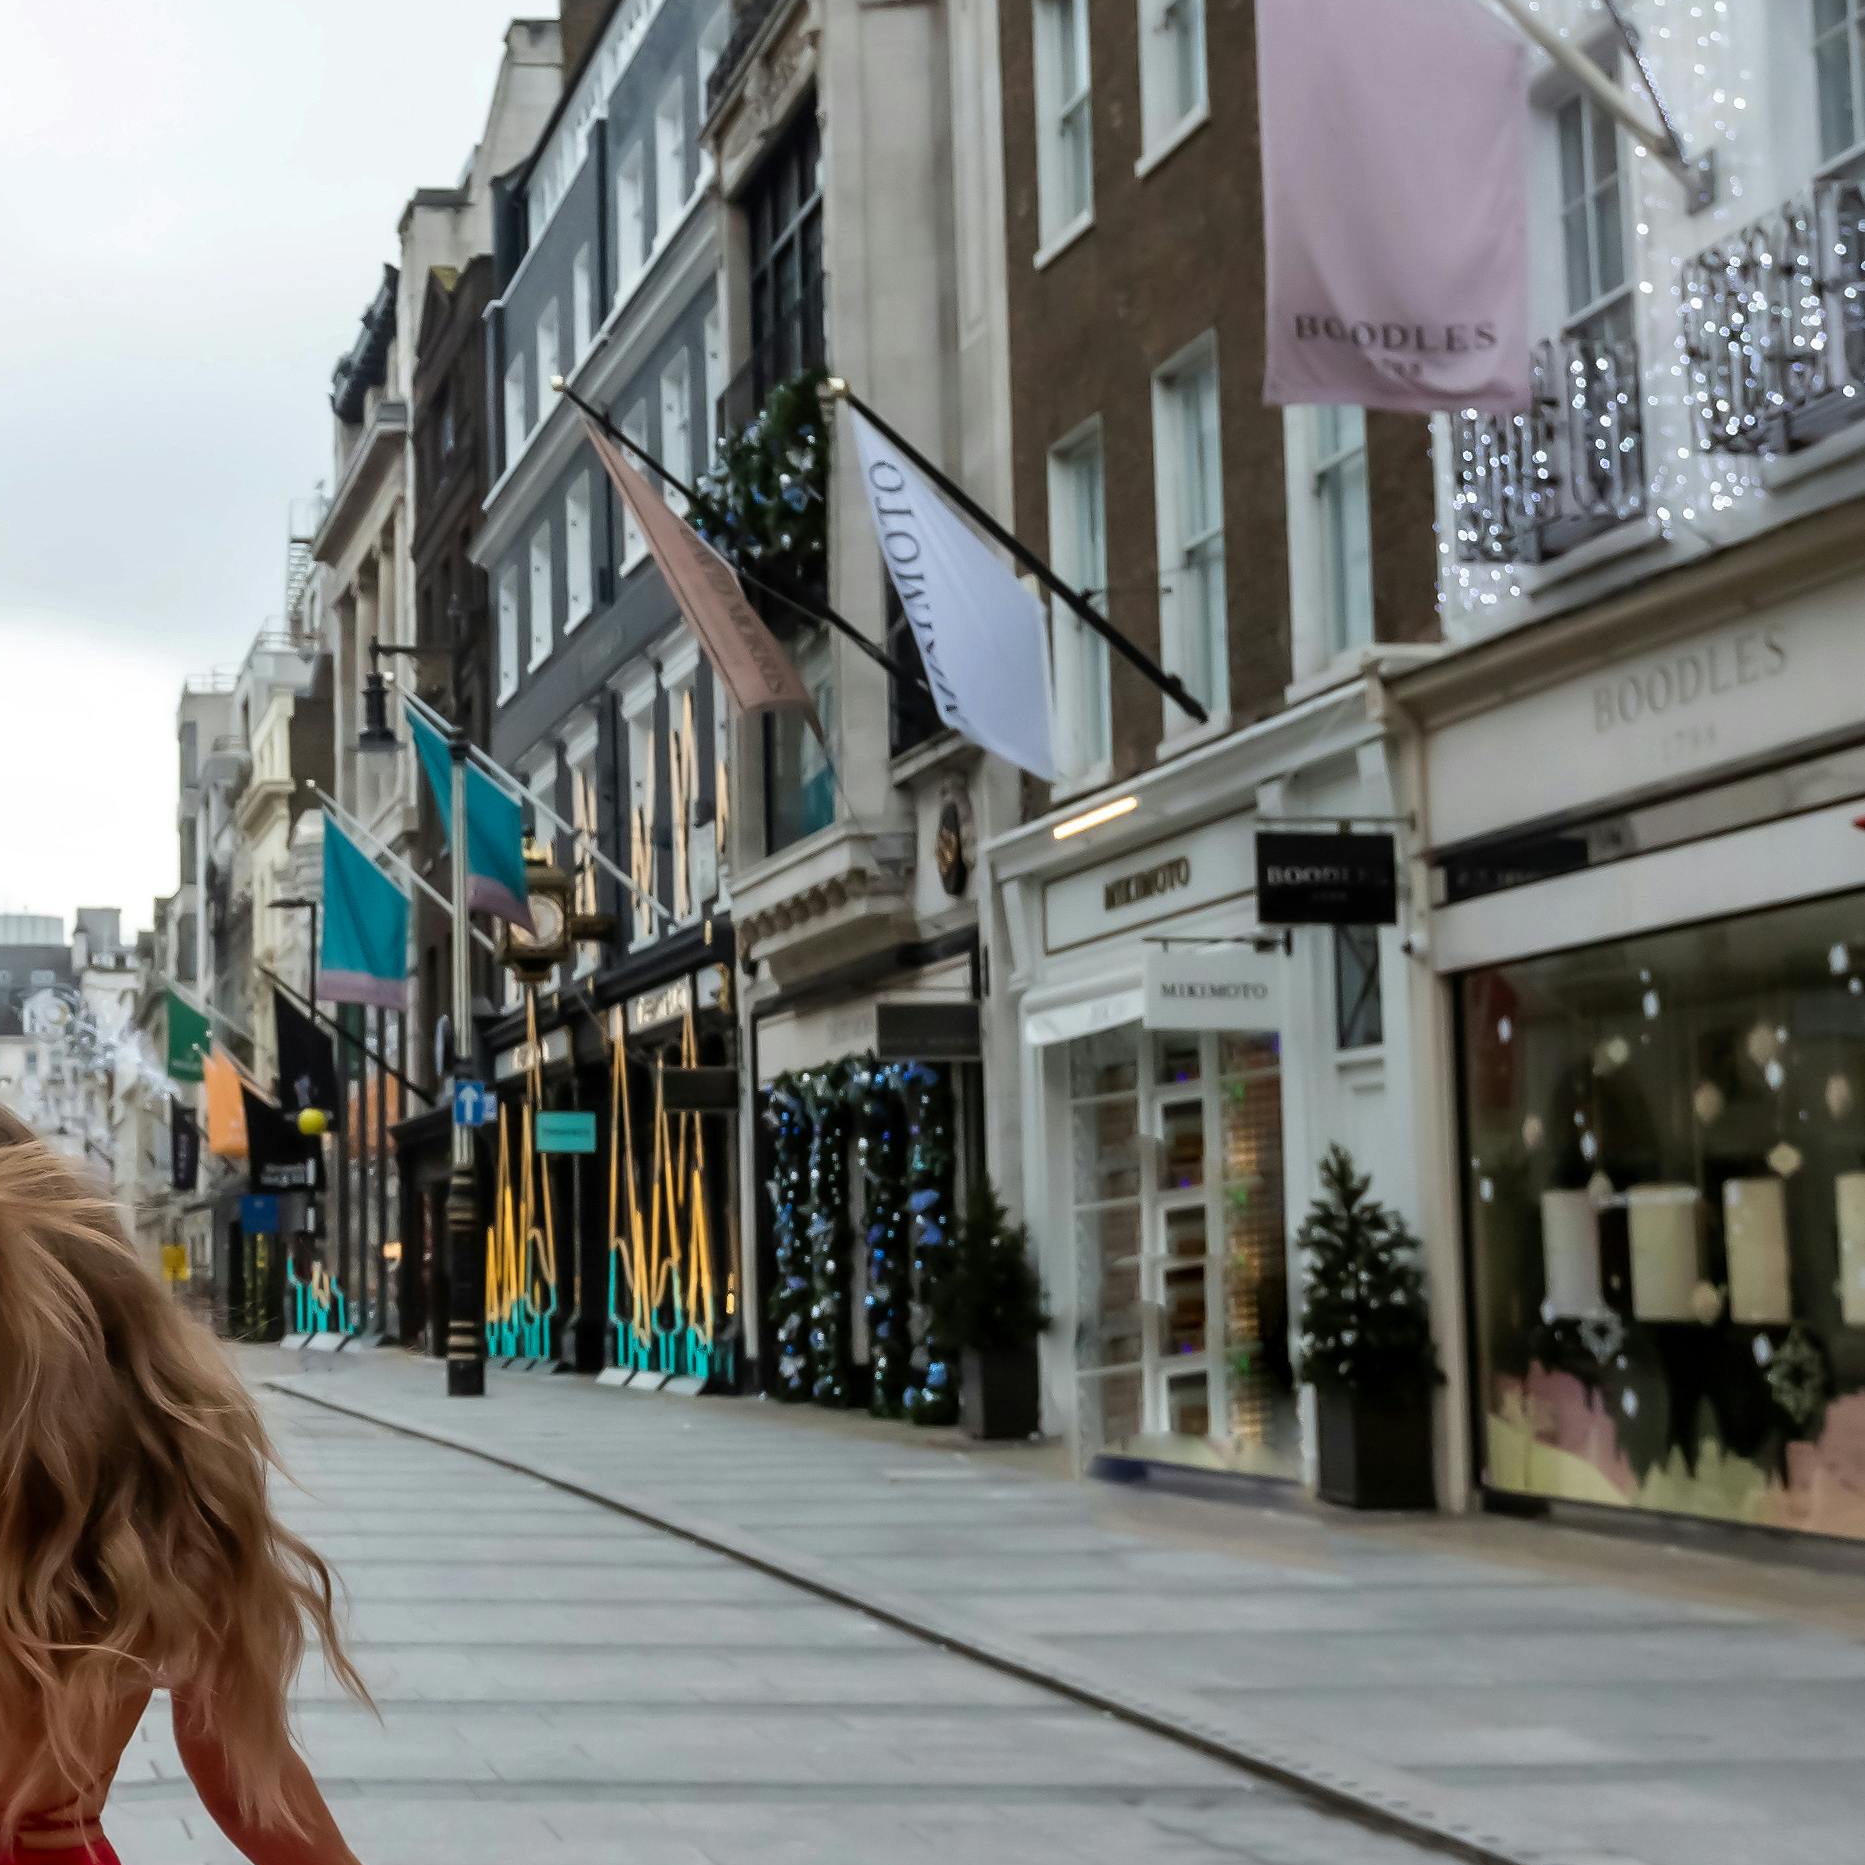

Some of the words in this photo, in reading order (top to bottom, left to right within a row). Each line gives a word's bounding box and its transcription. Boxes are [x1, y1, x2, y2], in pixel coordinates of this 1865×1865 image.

[1294, 313, 1498, 353] BOODLES
[1592, 631, 1788, 735] BOODLES
[1161, 983, 1268, 998] MIKIMOTO
